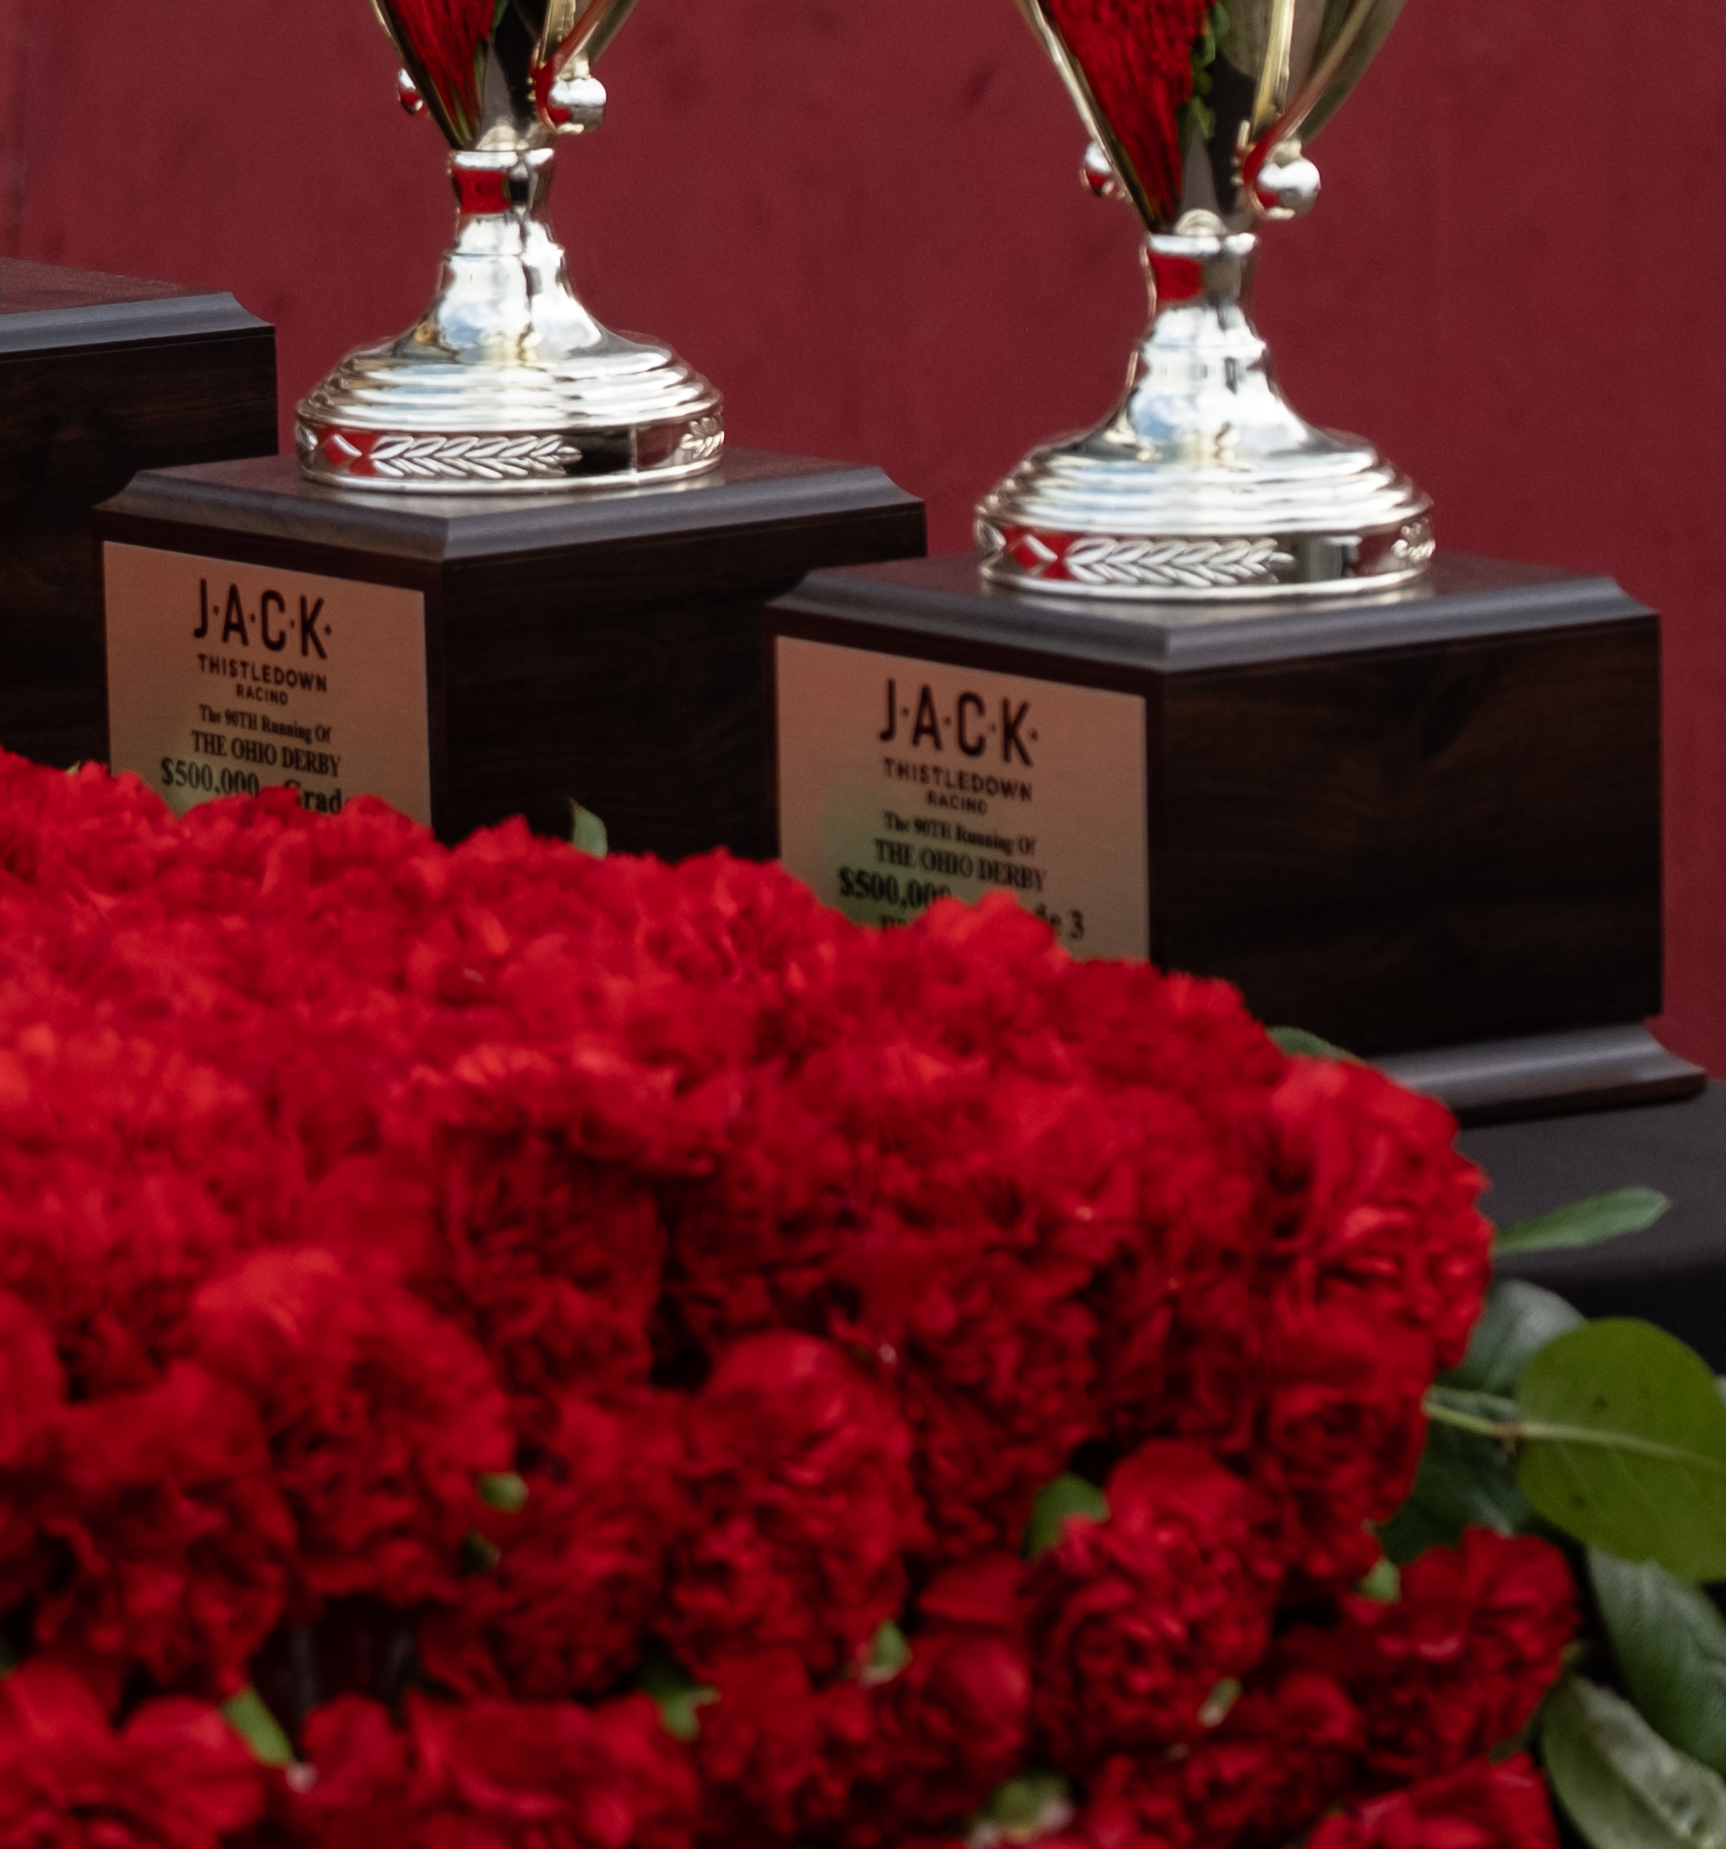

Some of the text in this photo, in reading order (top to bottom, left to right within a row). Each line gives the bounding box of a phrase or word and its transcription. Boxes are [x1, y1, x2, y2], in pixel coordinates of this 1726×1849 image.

[193, 578, 327, 660] JACK
[197, 653, 327, 693] THISTLEDOWN
[236, 684, 289, 706] RACINO
[199, 703, 332, 745] The 90TH Running Of
[878, 678, 1034, 768] JACK
[191, 730, 341, 778] THE OHIO DERBY
[883, 757, 1034, 803] THISTLEDOWN
[927, 790, 987, 816] RACINO
[884, 811, 1037, 856] The 90TH Running Of
[874, 838, 1048, 892] THE OHIO DERBY
[1070, 908, 1085, 940] 3
